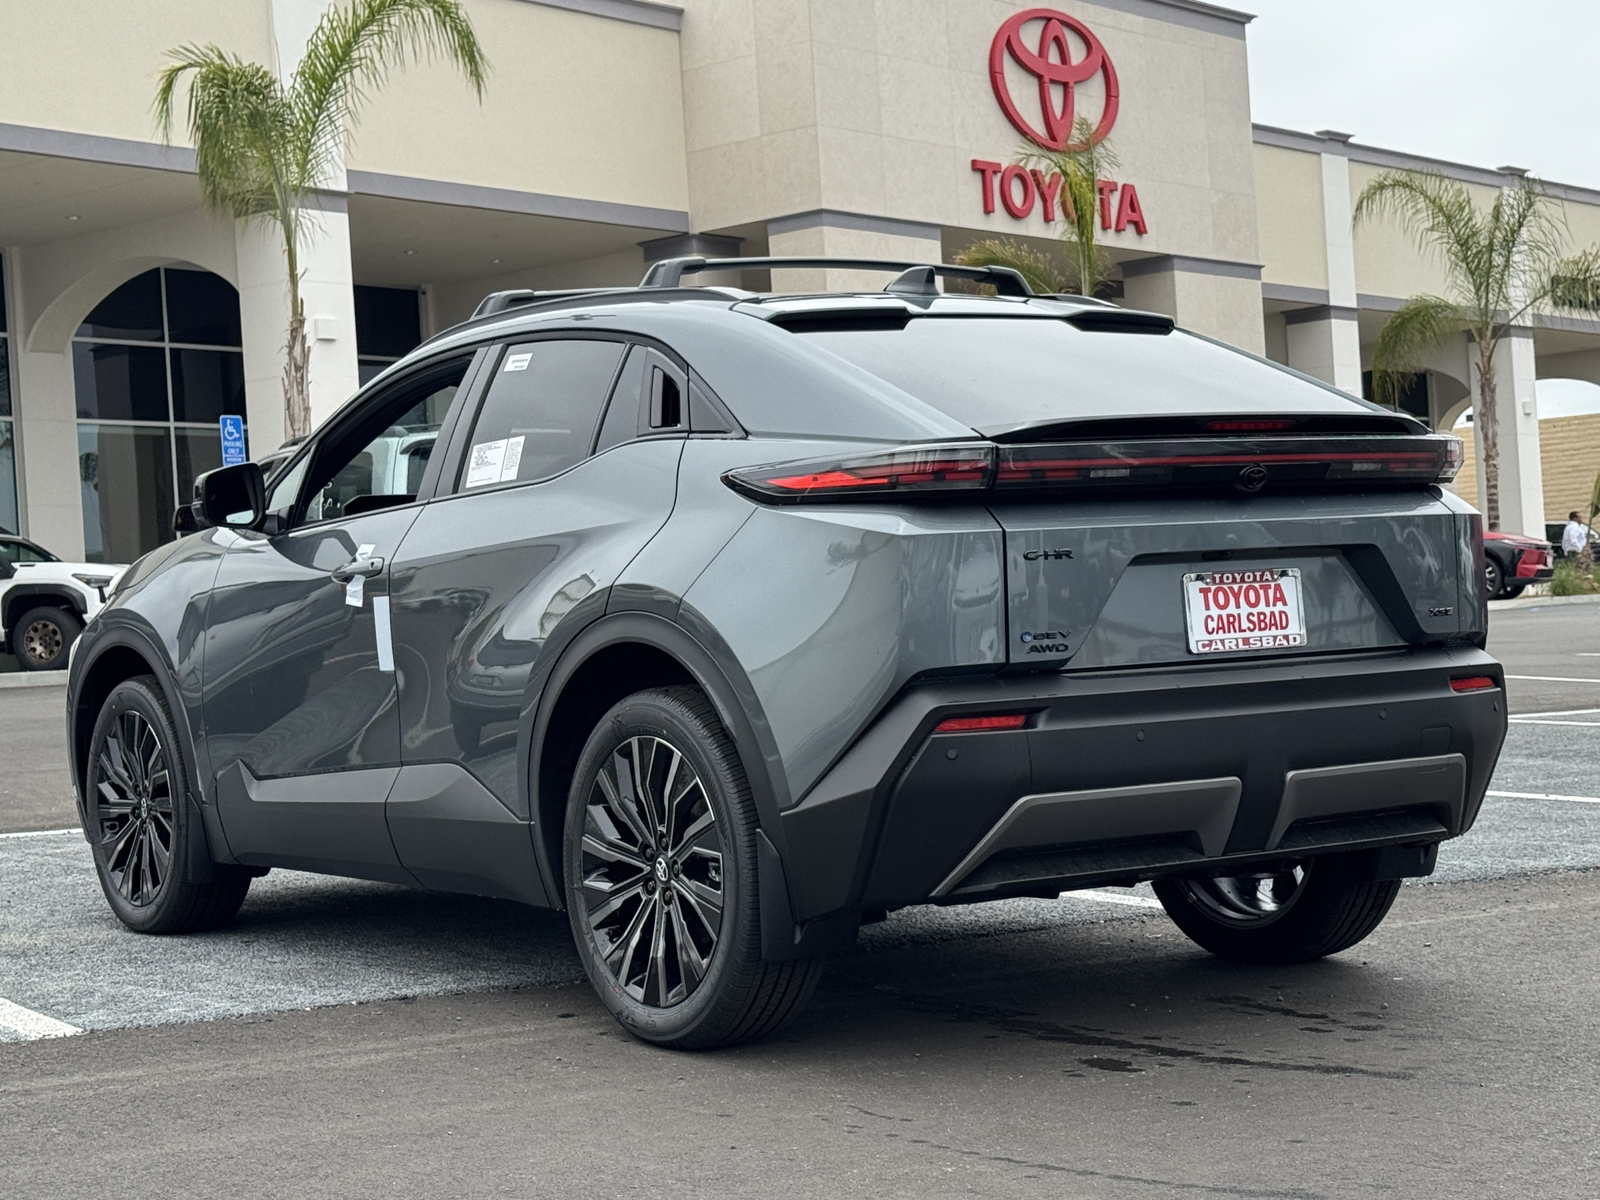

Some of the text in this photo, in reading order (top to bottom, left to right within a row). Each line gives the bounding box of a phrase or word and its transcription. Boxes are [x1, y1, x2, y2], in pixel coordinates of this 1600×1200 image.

[1213, 571, 1273, 584] TOYOTA
[1198, 583, 1288, 611] TOYOTA
[1428, 606, 1454, 617] XSE
[1203, 610, 1290, 636] CARLSBAD
[1026, 643, 1069, 655] AWD
[1197, 634, 1302, 652] CARLSBAD
